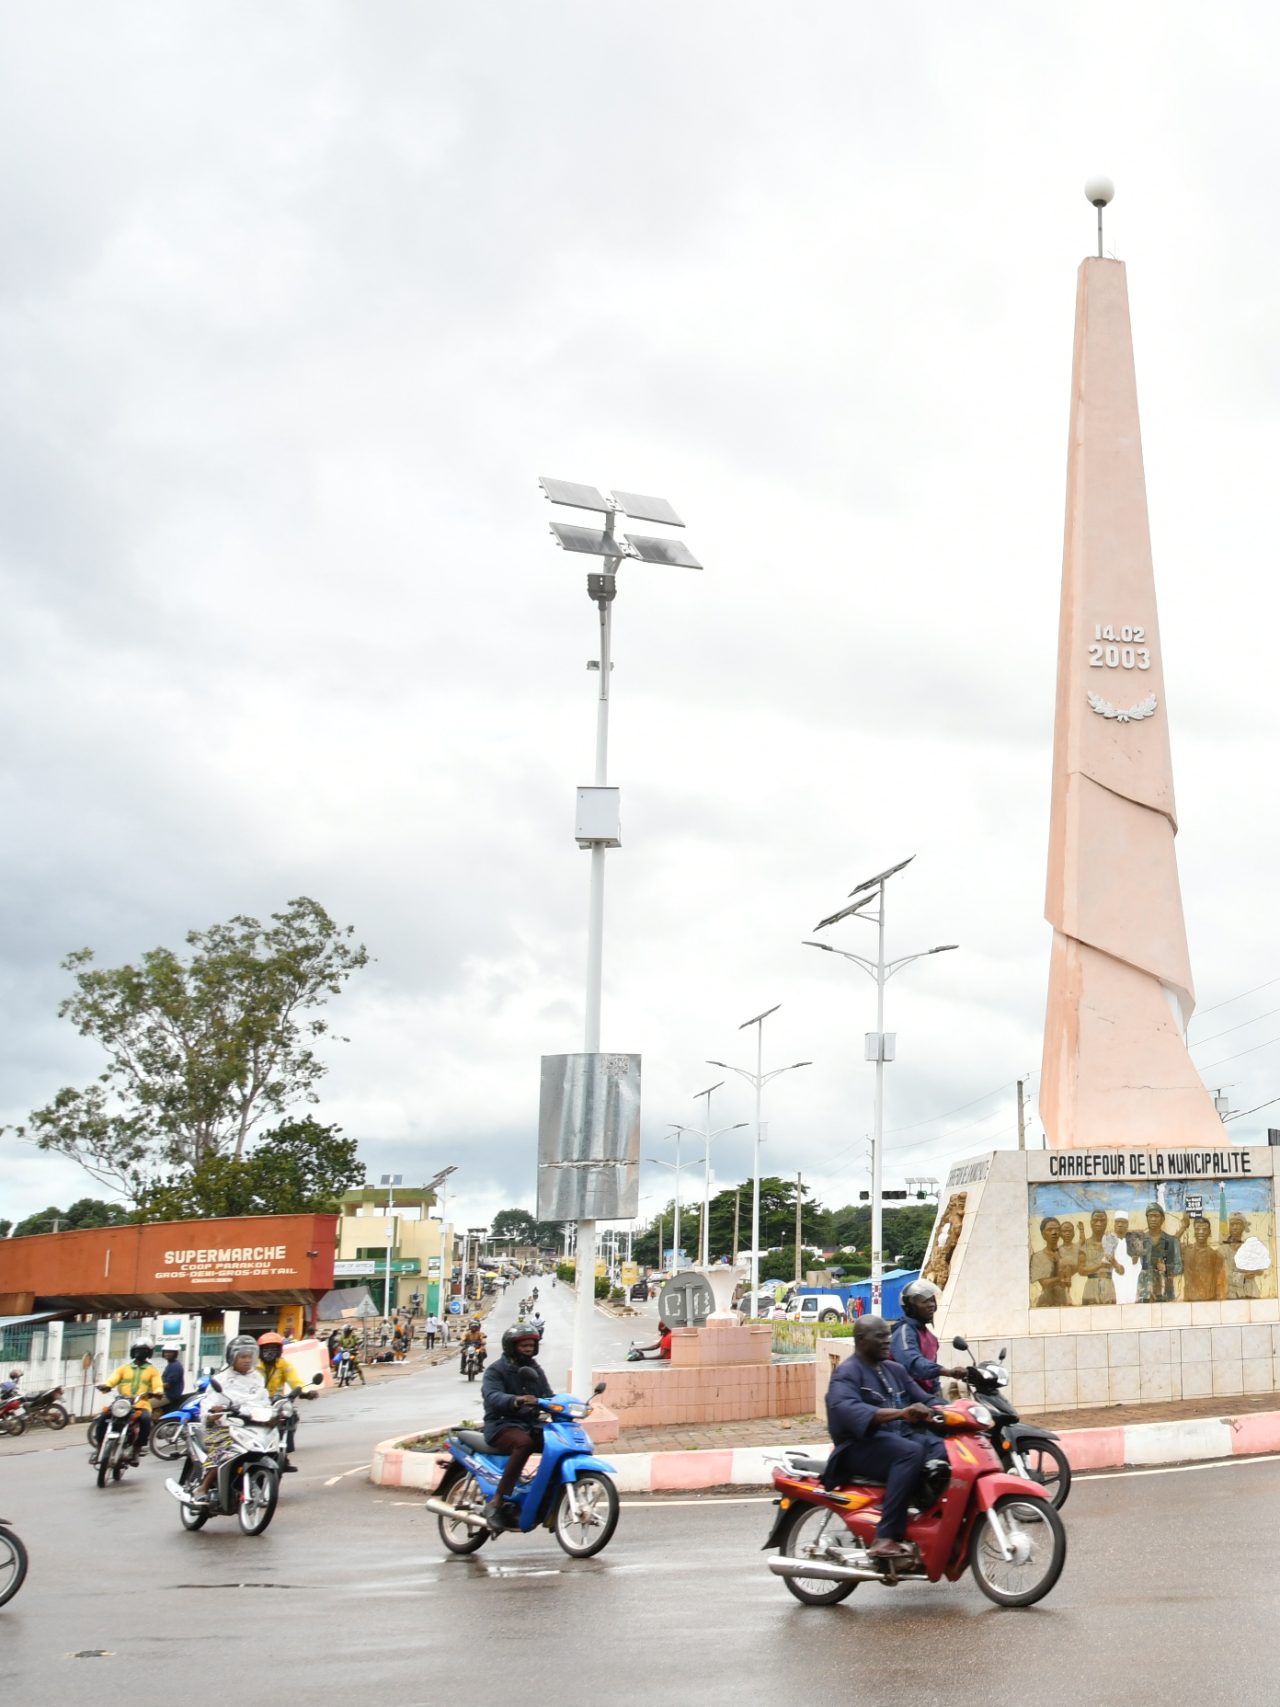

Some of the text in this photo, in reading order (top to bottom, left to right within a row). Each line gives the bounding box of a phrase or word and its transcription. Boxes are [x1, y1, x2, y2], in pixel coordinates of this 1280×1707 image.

[1095, 623, 1145, 644] 14.02
[1088, 644, 1150, 670] 2003
[1049, 1152, 1251, 1176] CARREFOUR DE LA MUNICIPALITE
[164, 1245, 286, 1264] SUPERMARCHE
[180, 1261, 271, 1271] COOP PARAKOU
